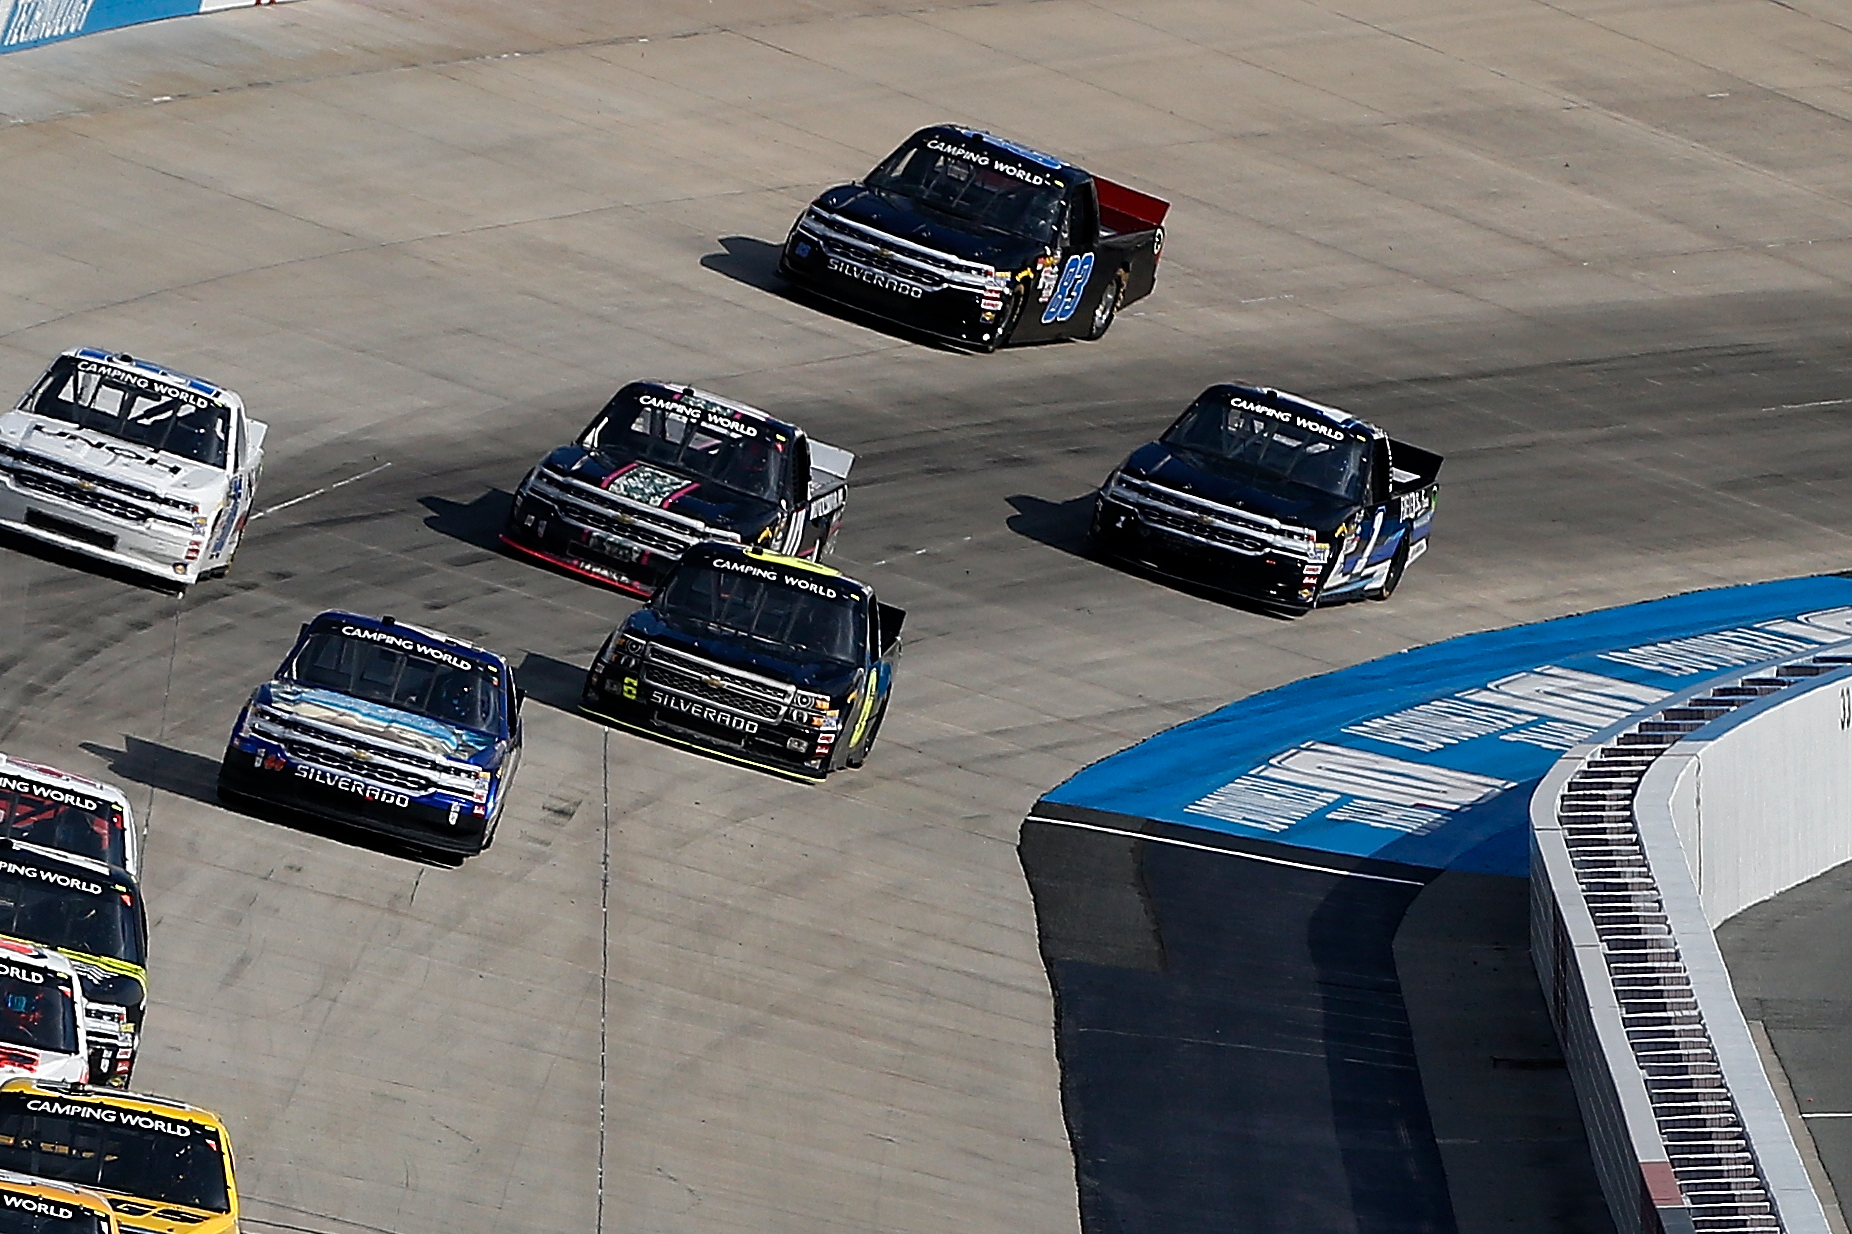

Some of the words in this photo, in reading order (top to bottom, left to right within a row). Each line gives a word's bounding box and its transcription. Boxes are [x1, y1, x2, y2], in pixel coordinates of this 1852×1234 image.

[926, 139, 990, 166] CAMPING
[994, 162, 1043, 186] WORLD
[827, 257, 923, 300] SILVERADO
[77, 360, 149, 386] CAMPING
[152, 380, 208, 409] WORLD
[639, 395, 701, 419] CAMPING
[707, 413, 758, 438] WORLD
[1230, 397, 1292, 422] CAMPING
[1296, 416, 1344, 441] WORLD
[712, 559, 777, 581] CAMPING
[784, 575, 837, 598] WORLD
[342, 626, 414, 650] CAMPING
[416, 644, 472, 671] WORLD
[651, 690, 759, 734] SILVERADO
[32, 786, 97, 811] WORLD
[294, 764, 410, 808] SILVERADO
[39, 869, 102, 895] WORLD
[26, 1099, 116, 1122] CAMPING
[119, 1113, 190, 1137] WORLD
[3, 1195, 73, 1219] WORLD
